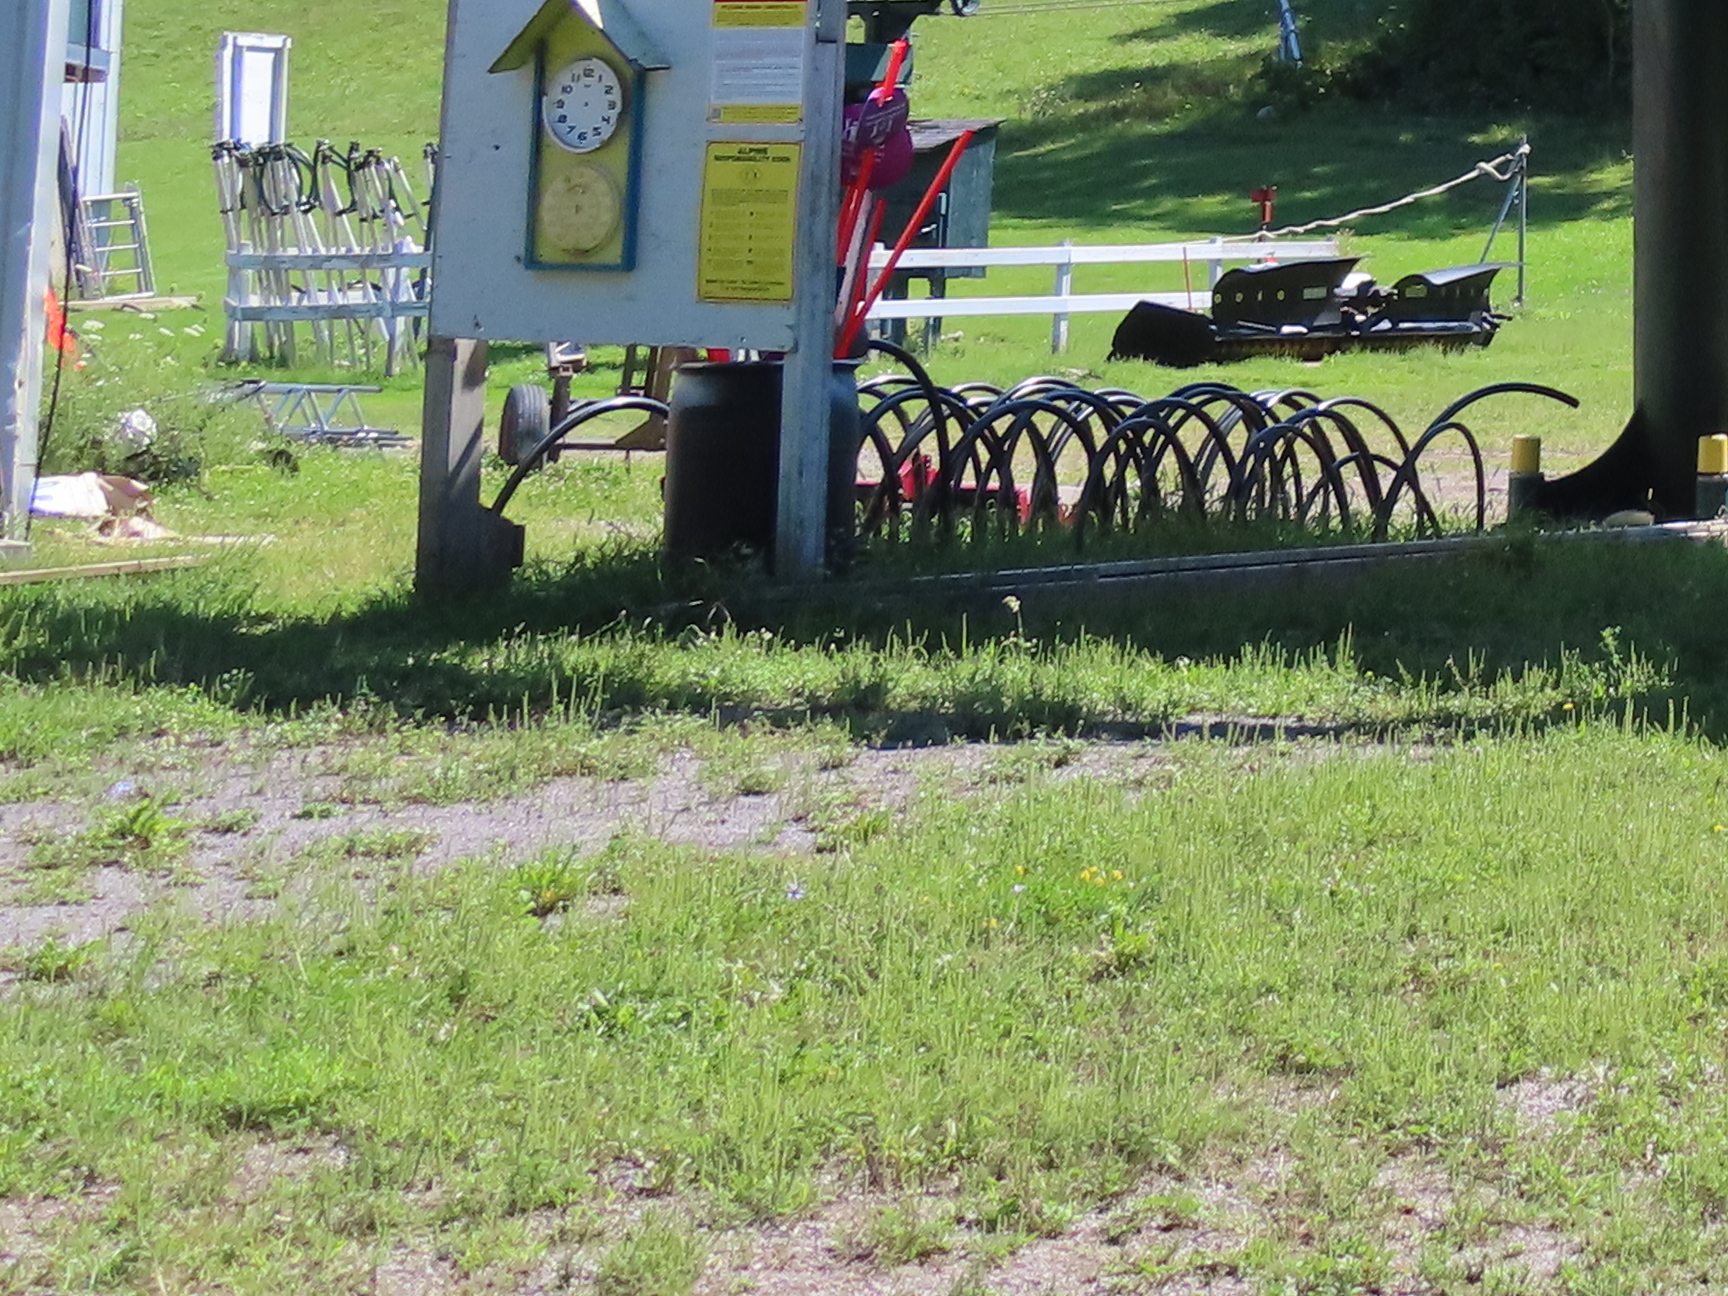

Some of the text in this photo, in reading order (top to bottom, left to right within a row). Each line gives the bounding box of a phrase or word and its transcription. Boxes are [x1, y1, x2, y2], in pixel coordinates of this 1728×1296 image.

[571, 72, 580, 83] 11
[583, 68, 595, 78] 12
[598, 74, 602, 83] 1
[561, 85, 573, 95] 10
[604, 85, 614, 95] 2
[608, 100, 617, 111] 3
[557, 114, 568, 124] 8
[601, 115, 611, 125] 4
[566, 125, 577, 135] 7
[592, 126, 602, 137] 5
[577, 131, 588, 141] 6
